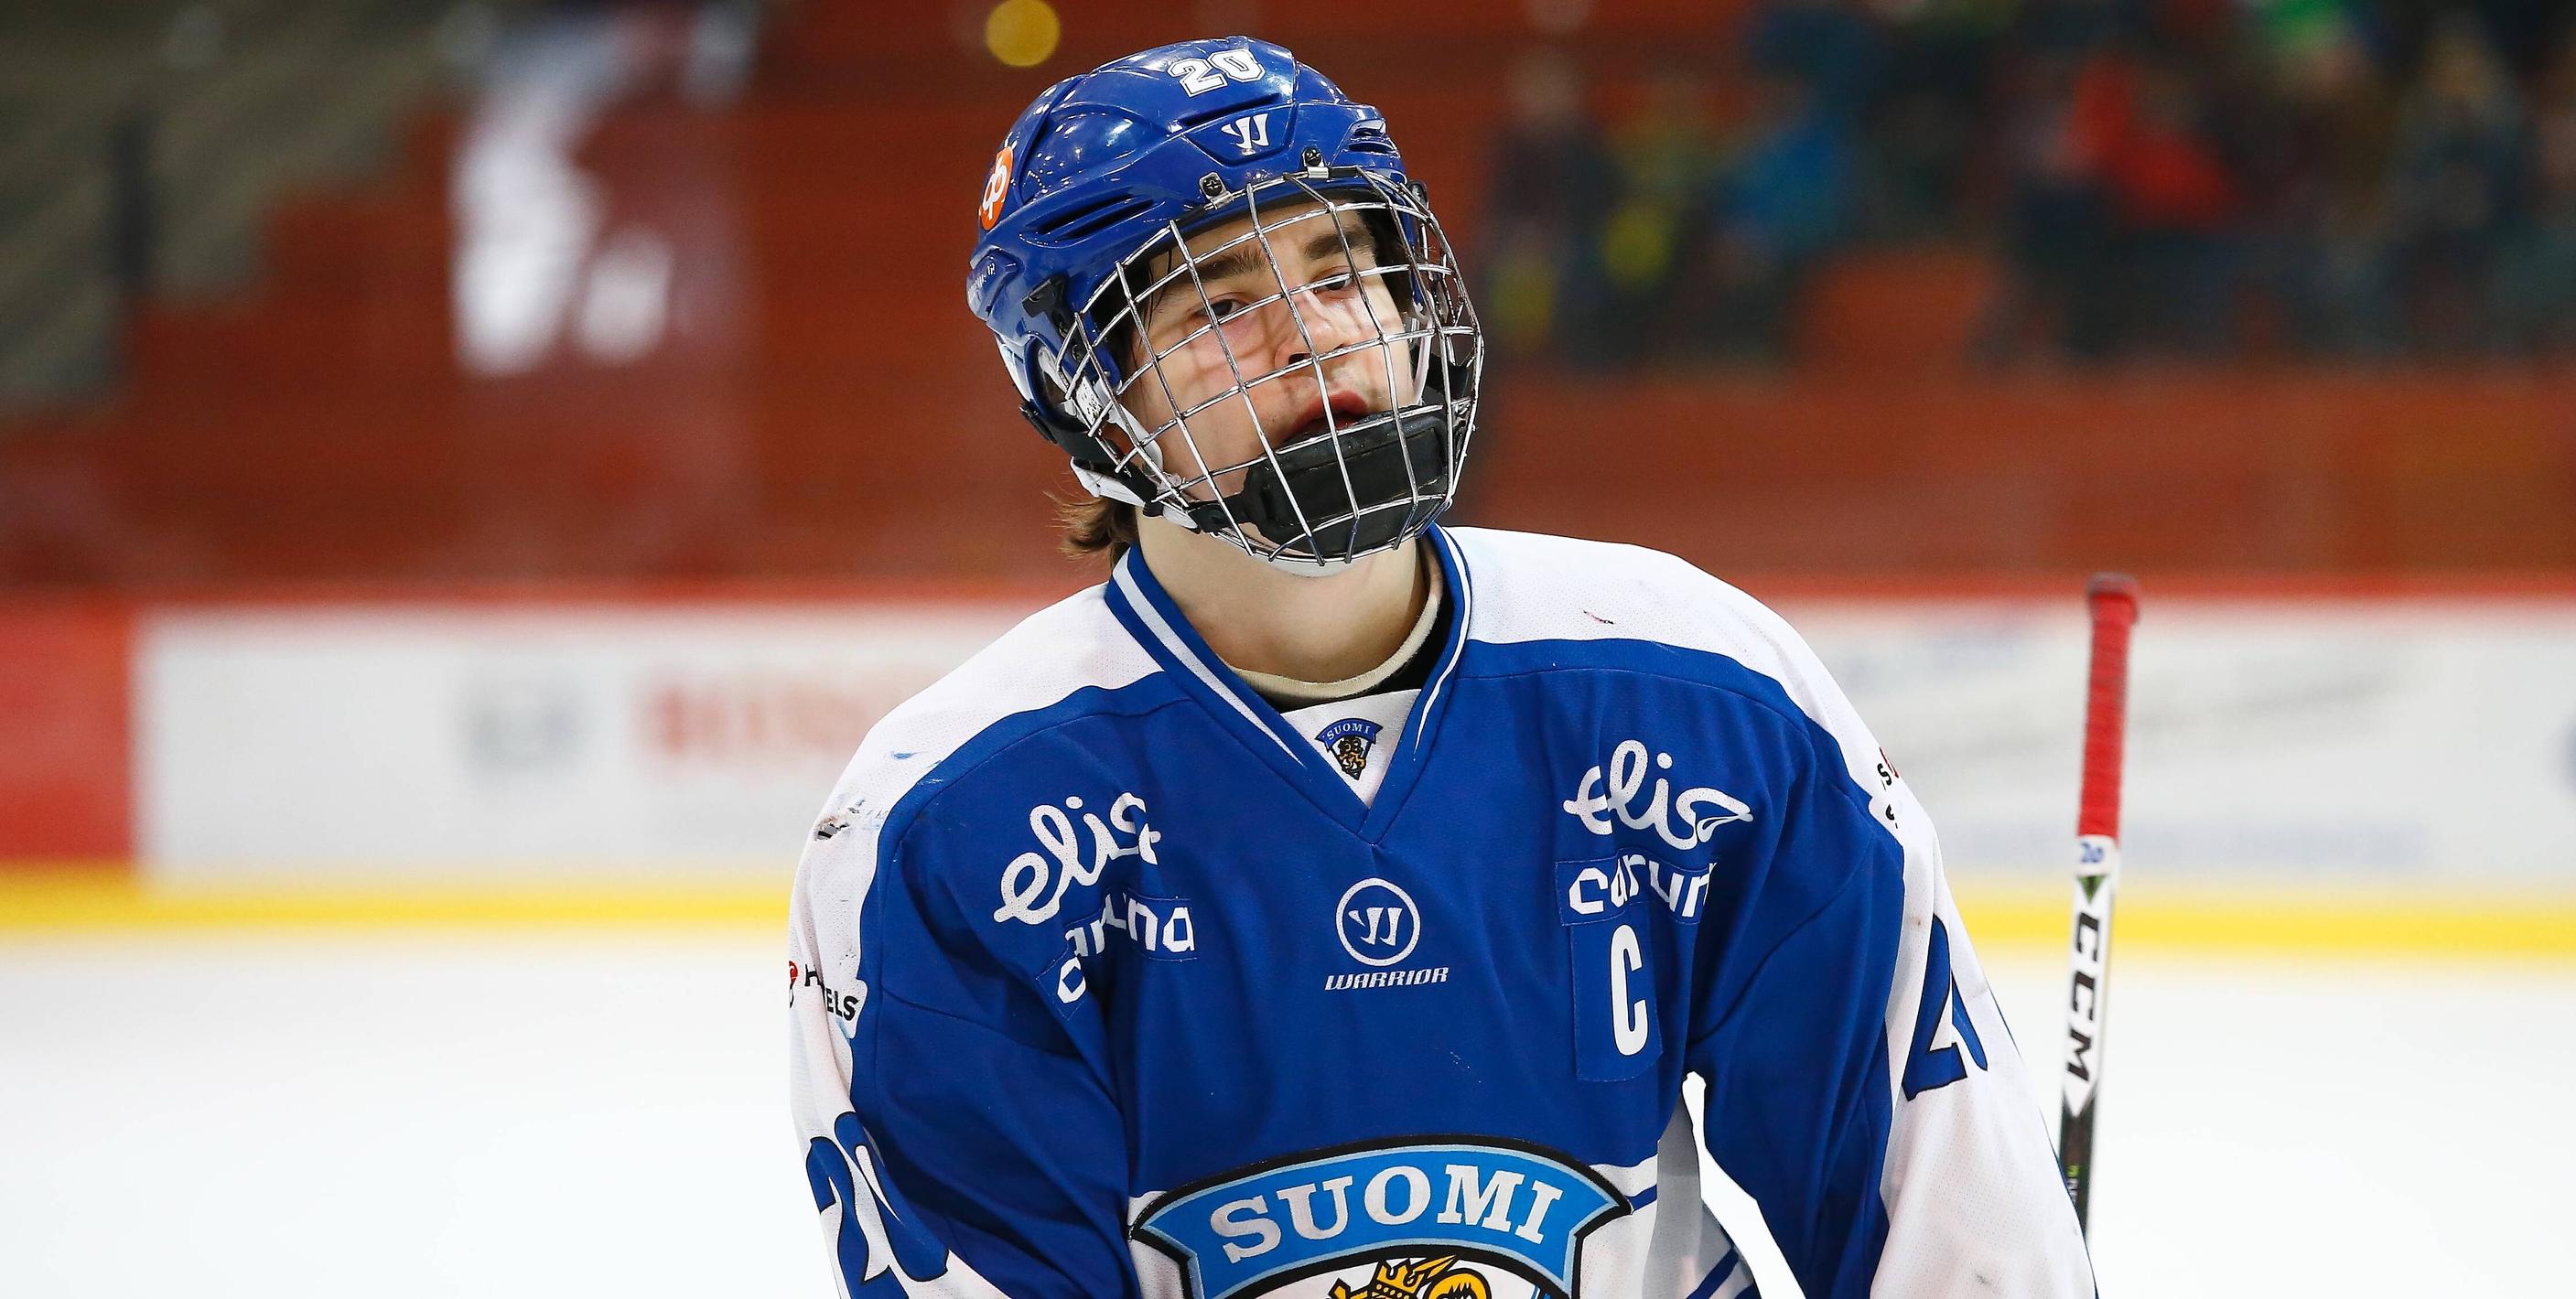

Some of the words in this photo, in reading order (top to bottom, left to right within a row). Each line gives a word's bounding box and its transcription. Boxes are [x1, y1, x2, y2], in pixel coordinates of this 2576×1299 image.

[1167, 48, 1266, 98] 20
[1326, 723, 1372, 740] SUOMI
[804, 963, 858, 1021] HELS
[1324, 966, 1450, 991] WARRIOR
[1611, 924, 1648, 1056] C
[2067, 911, 2100, 1083] CCM
[1209, 1163, 1564, 1265] SUOMI
